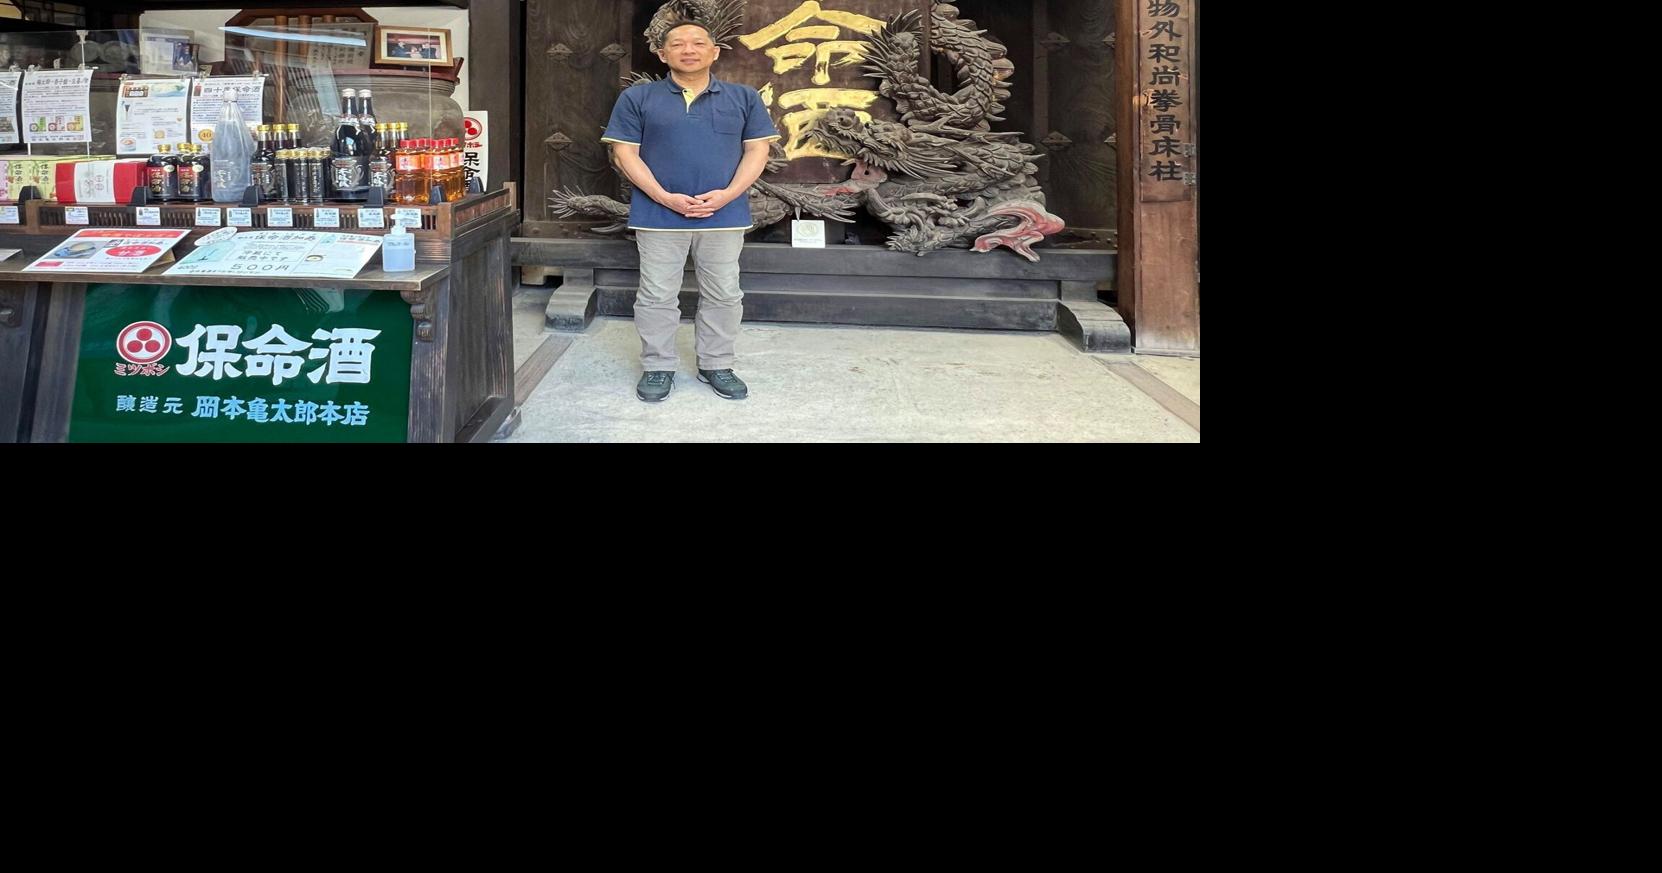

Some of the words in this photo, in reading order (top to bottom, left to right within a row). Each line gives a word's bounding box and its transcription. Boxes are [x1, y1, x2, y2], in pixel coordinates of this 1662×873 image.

[1148, 0, 1183, 182] 物外和尚拳骨床柱
[114, 362, 170, 377] ミツボシ
[175, 323, 382, 386] 保命酒
[191, 395, 370, 426] 岡本亀太郎本店
